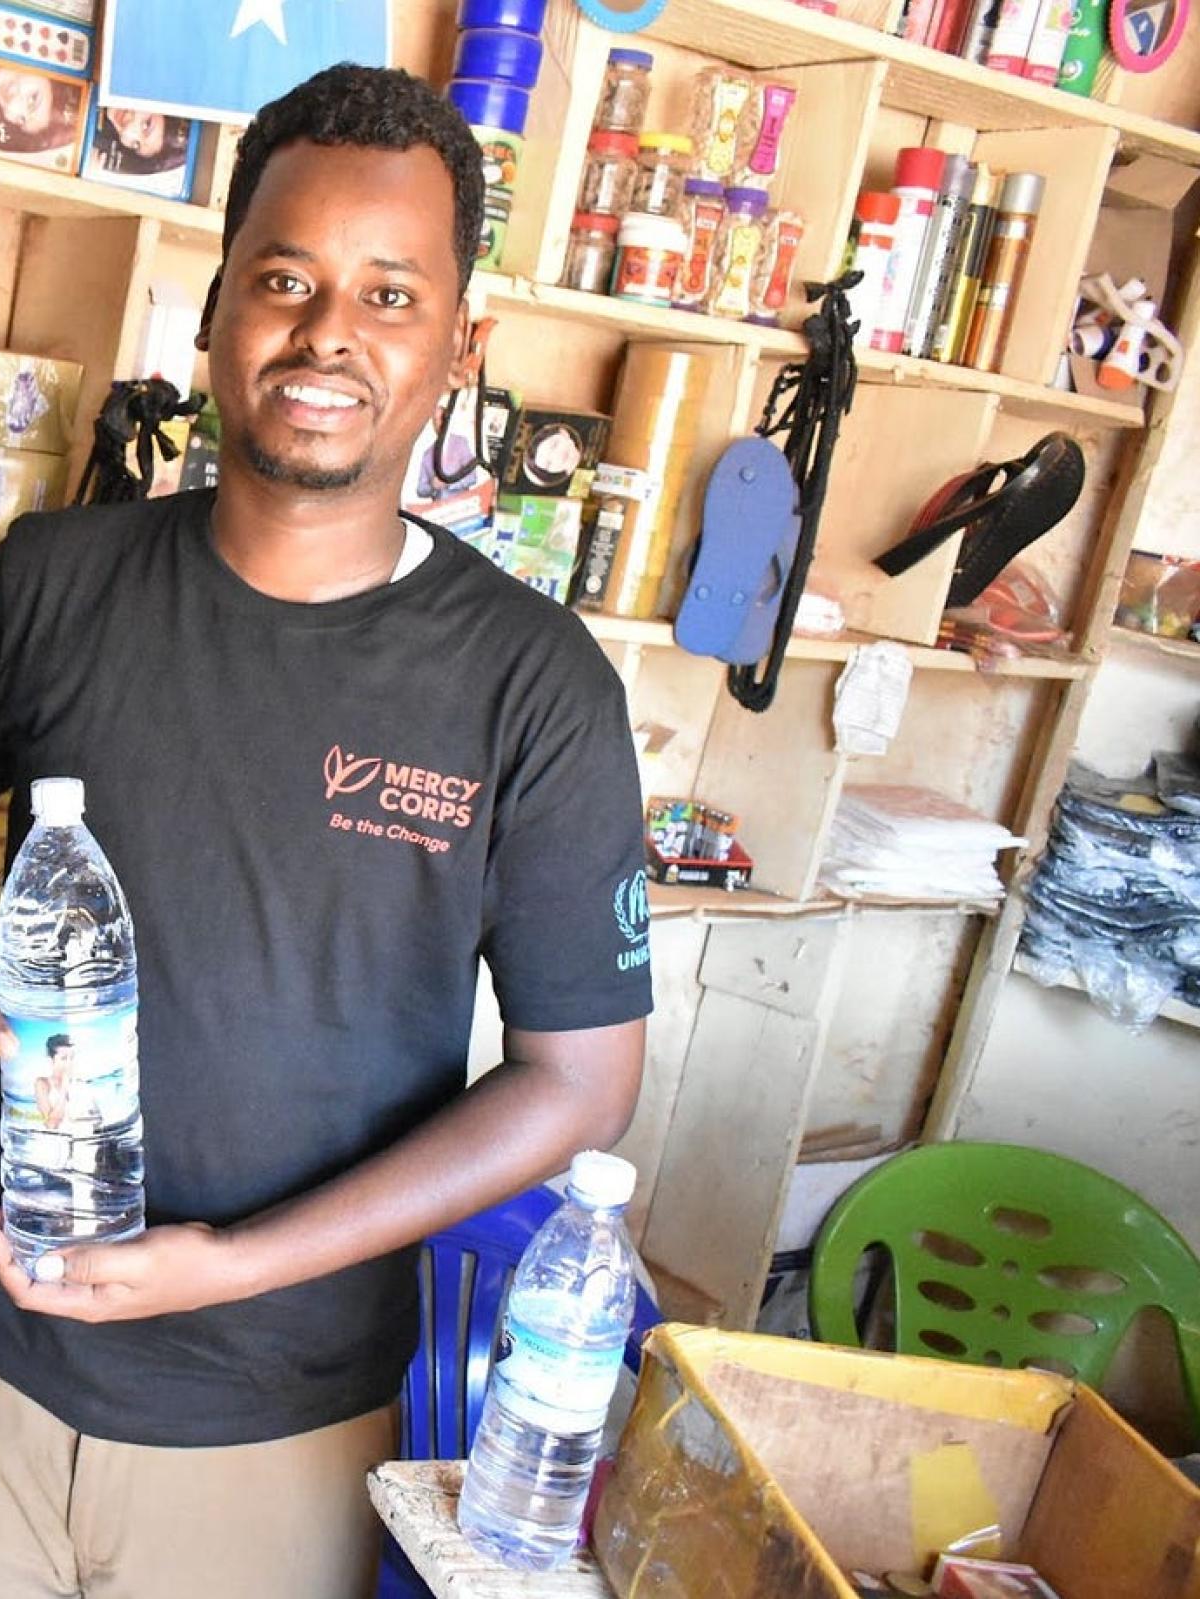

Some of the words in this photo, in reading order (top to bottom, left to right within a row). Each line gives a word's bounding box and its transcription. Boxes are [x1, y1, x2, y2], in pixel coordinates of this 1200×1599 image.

[385, 763, 482, 801] MERCY
[380, 787, 472, 828] CORPS
[330, 813, 352, 830] Be
[356, 819, 382, 836] the
[387, 824, 450, 853] Change
